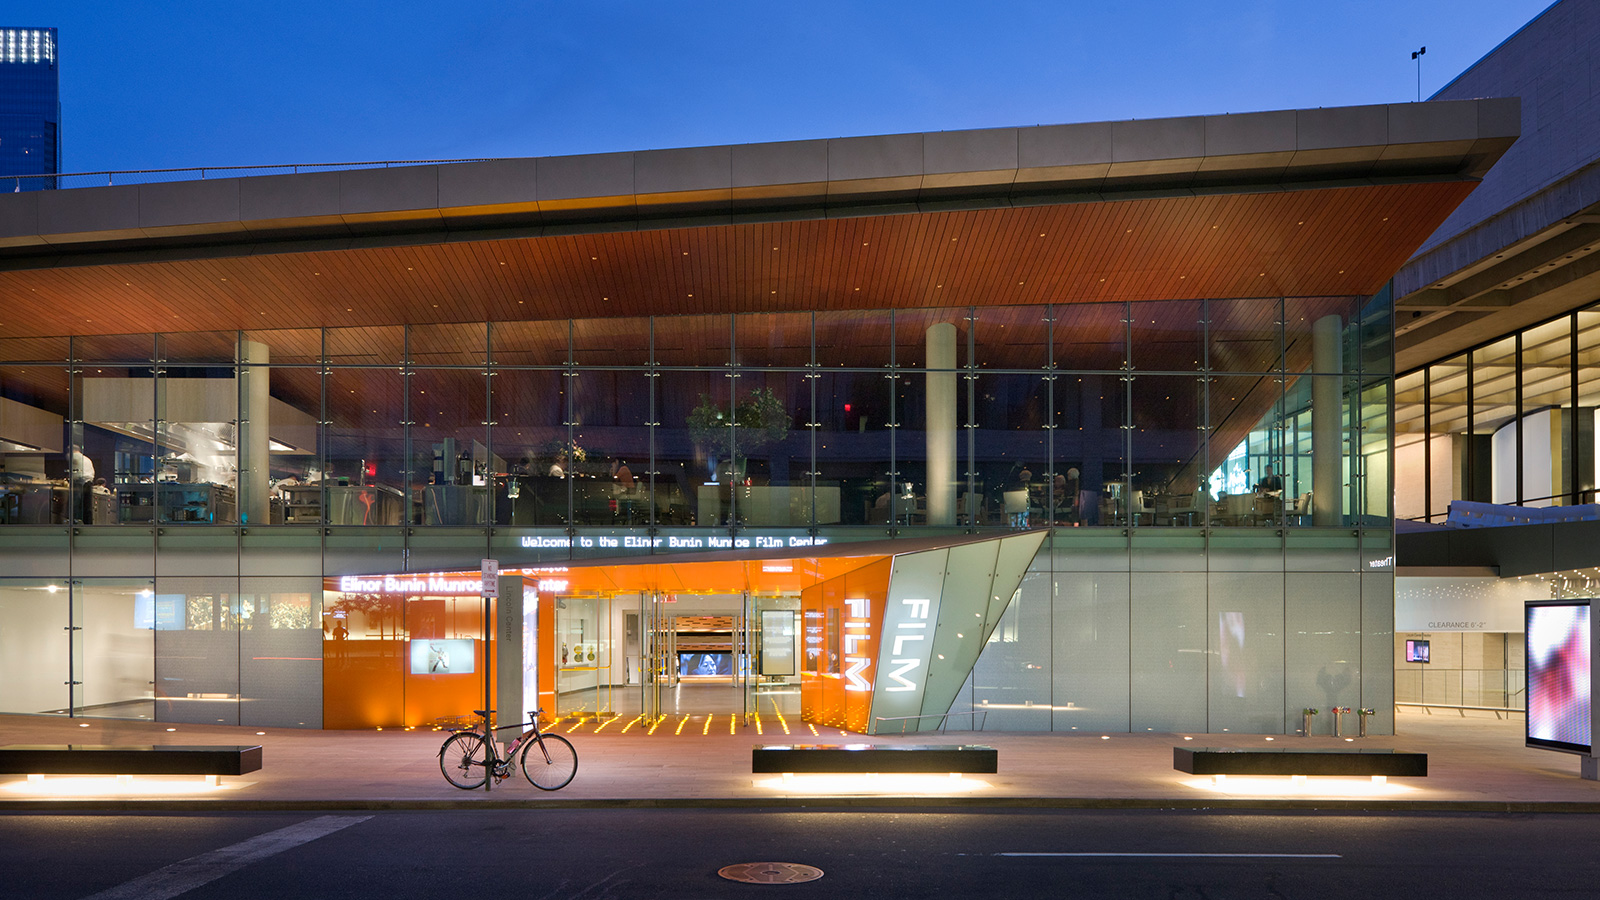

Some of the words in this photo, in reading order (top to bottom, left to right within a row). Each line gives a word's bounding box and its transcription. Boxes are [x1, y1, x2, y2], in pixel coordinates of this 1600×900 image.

[521, 536, 574, 547] Welcome
[580, 536, 593, 547] to
[599, 536, 618, 547] the
[624, 536, 662, 547] Elinor
[669, 536, 702, 547] Bunin
[708, 536, 750, 547] Munroe
[756, 536, 783, 547] Film
[341, 576, 382, 591] Elinor
[385, 577, 426, 591] Bunin
[429, 578, 482, 591] Munroe
[538, 580, 568, 591] nter
[505, 586, 513, 614] Lincoln
[505, 615, 513, 642] Center
[844, 598, 870, 691] FILM
[885, 599, 930, 692] FILM
